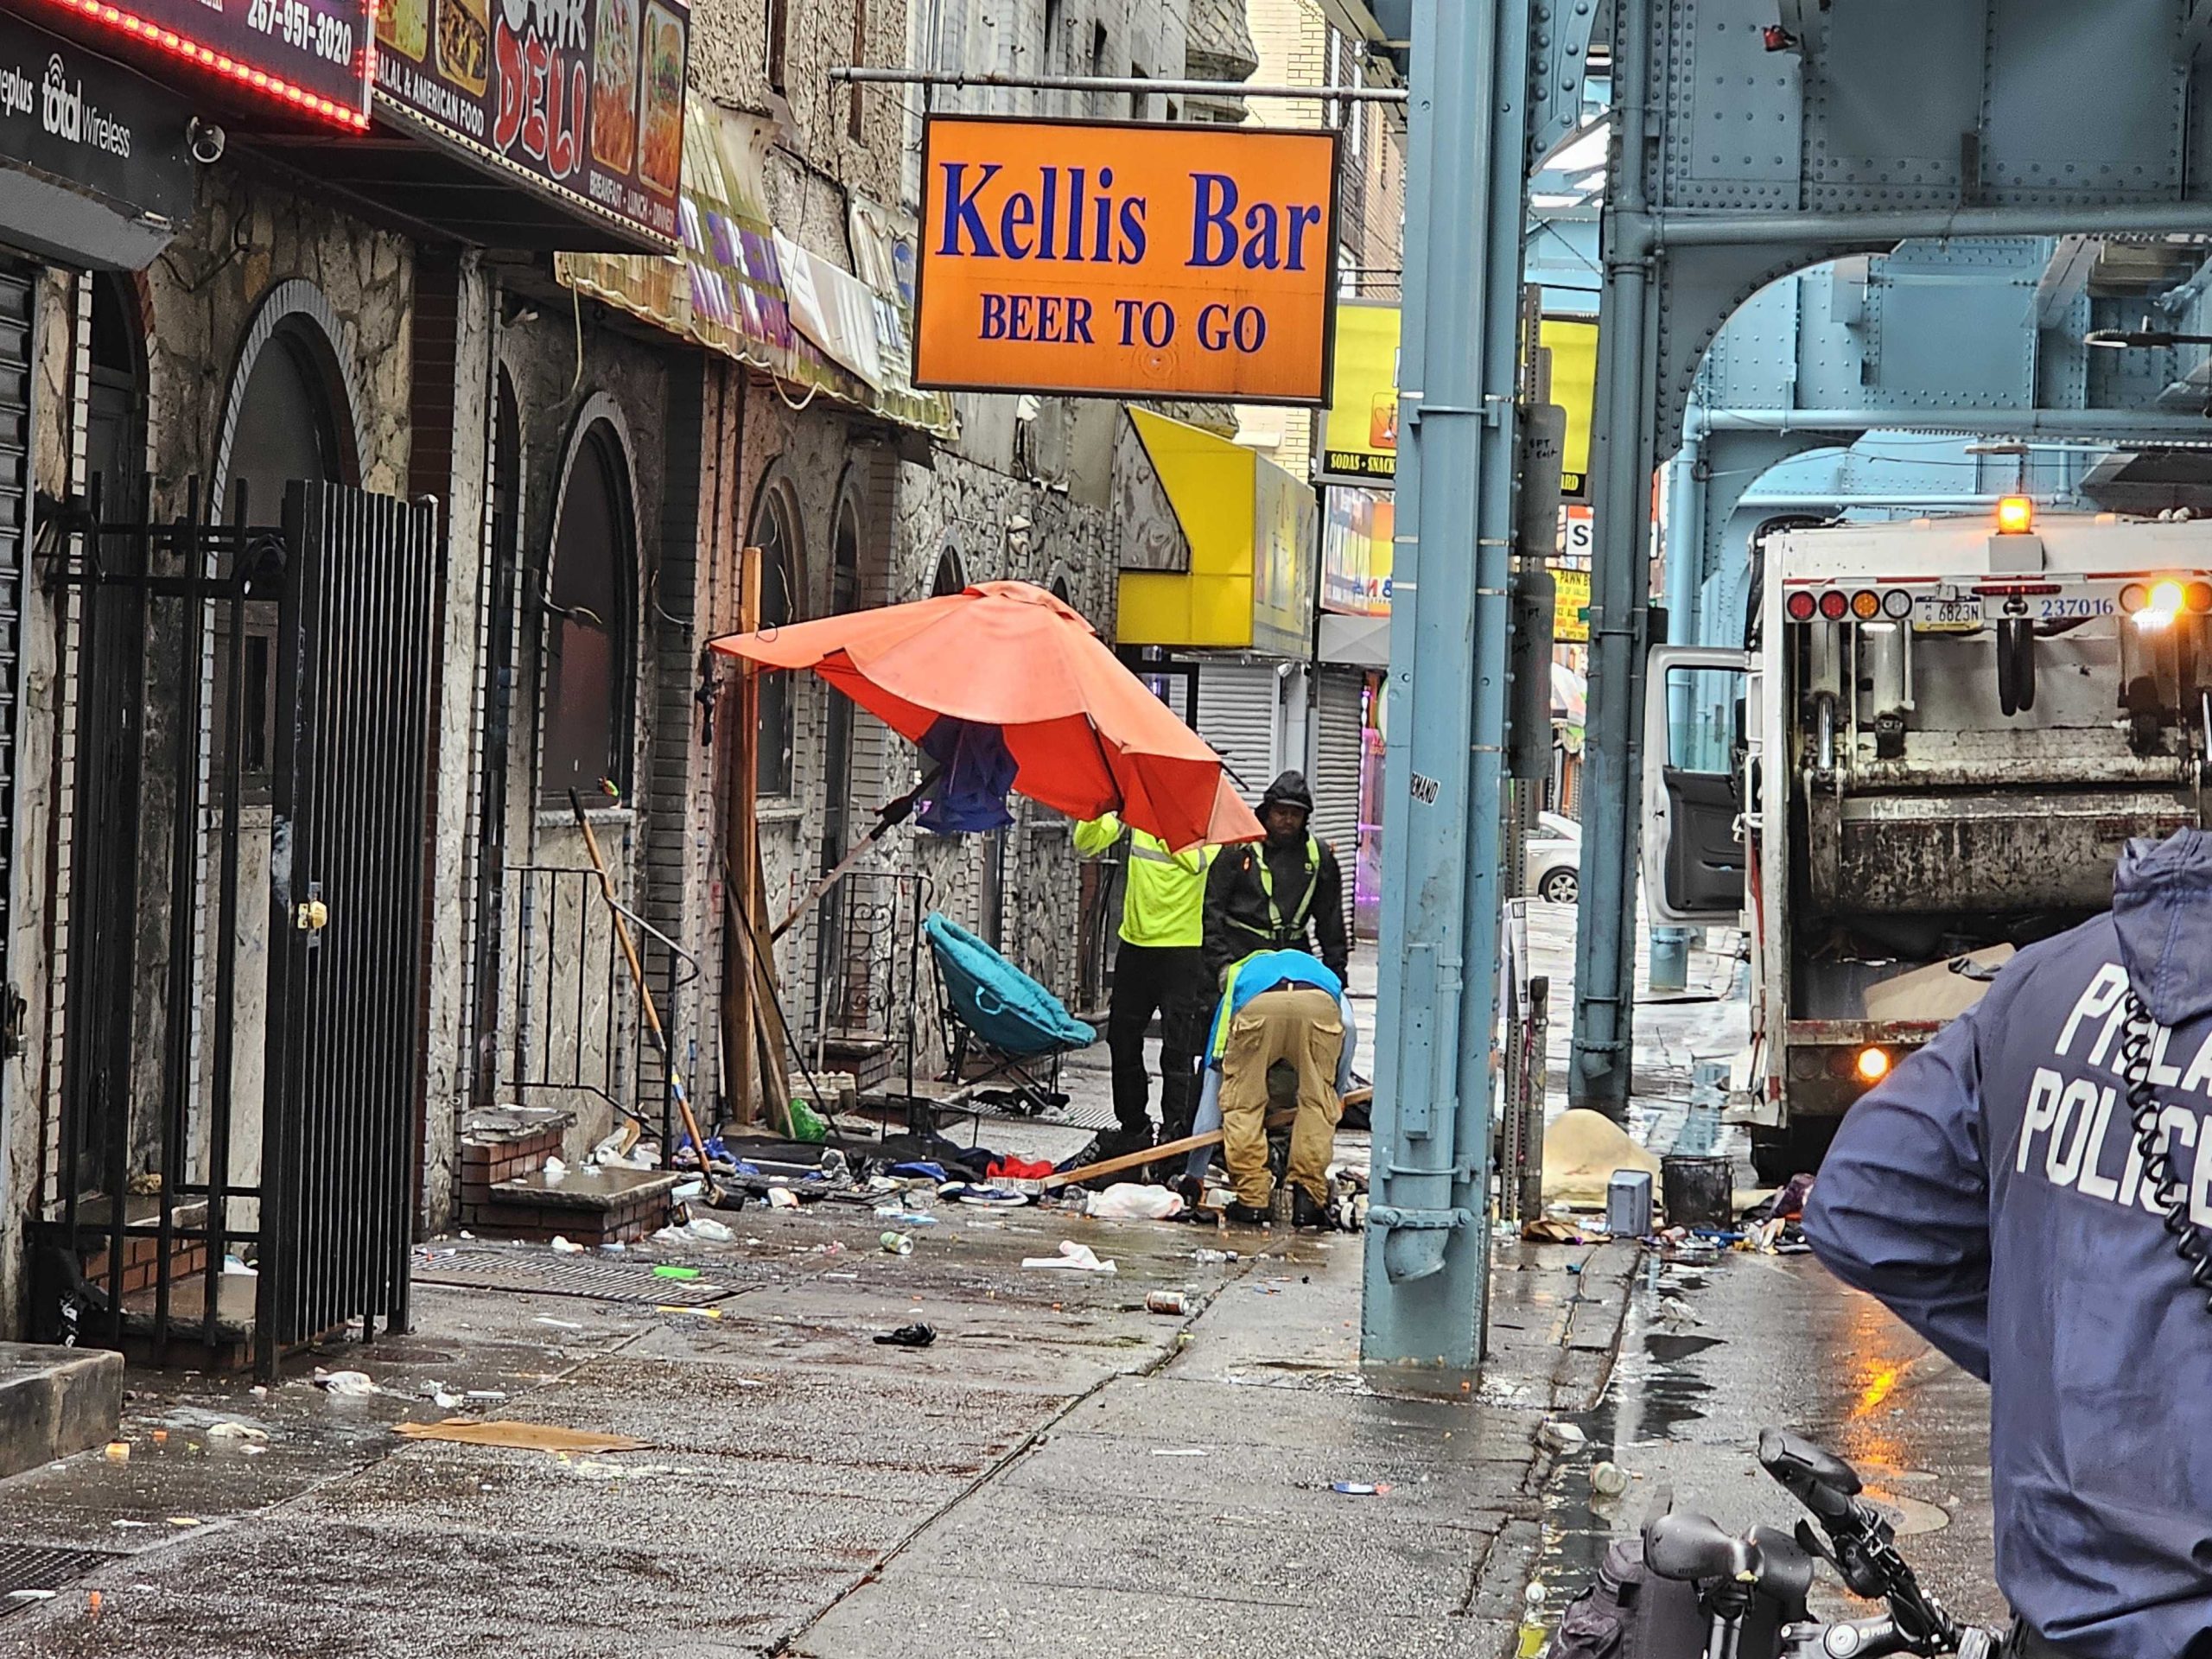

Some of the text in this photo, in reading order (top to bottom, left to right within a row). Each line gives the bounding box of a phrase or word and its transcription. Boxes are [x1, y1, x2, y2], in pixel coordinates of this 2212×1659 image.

[247, 0, 352, 67] 267-951-3020
[0, 66, 130, 159] eplus total Wireless
[412, 73, 460, 125] AMERICAN
[460, 99, 485, 138] FOOD
[493, 13, 588, 181] DELI
[934, 162, 1322, 271] Kellis Bar
[976, 292, 1268, 354] BEER TO GO
[1331, 453, 1361, 471] SODAS
[1560, 570, 1582, 585] PAWN
[2040, 598, 2114, 617] 237016
[1938, 603, 1980, 622] 6823N
[2016, 1066, 2212, 1230] POLICE
